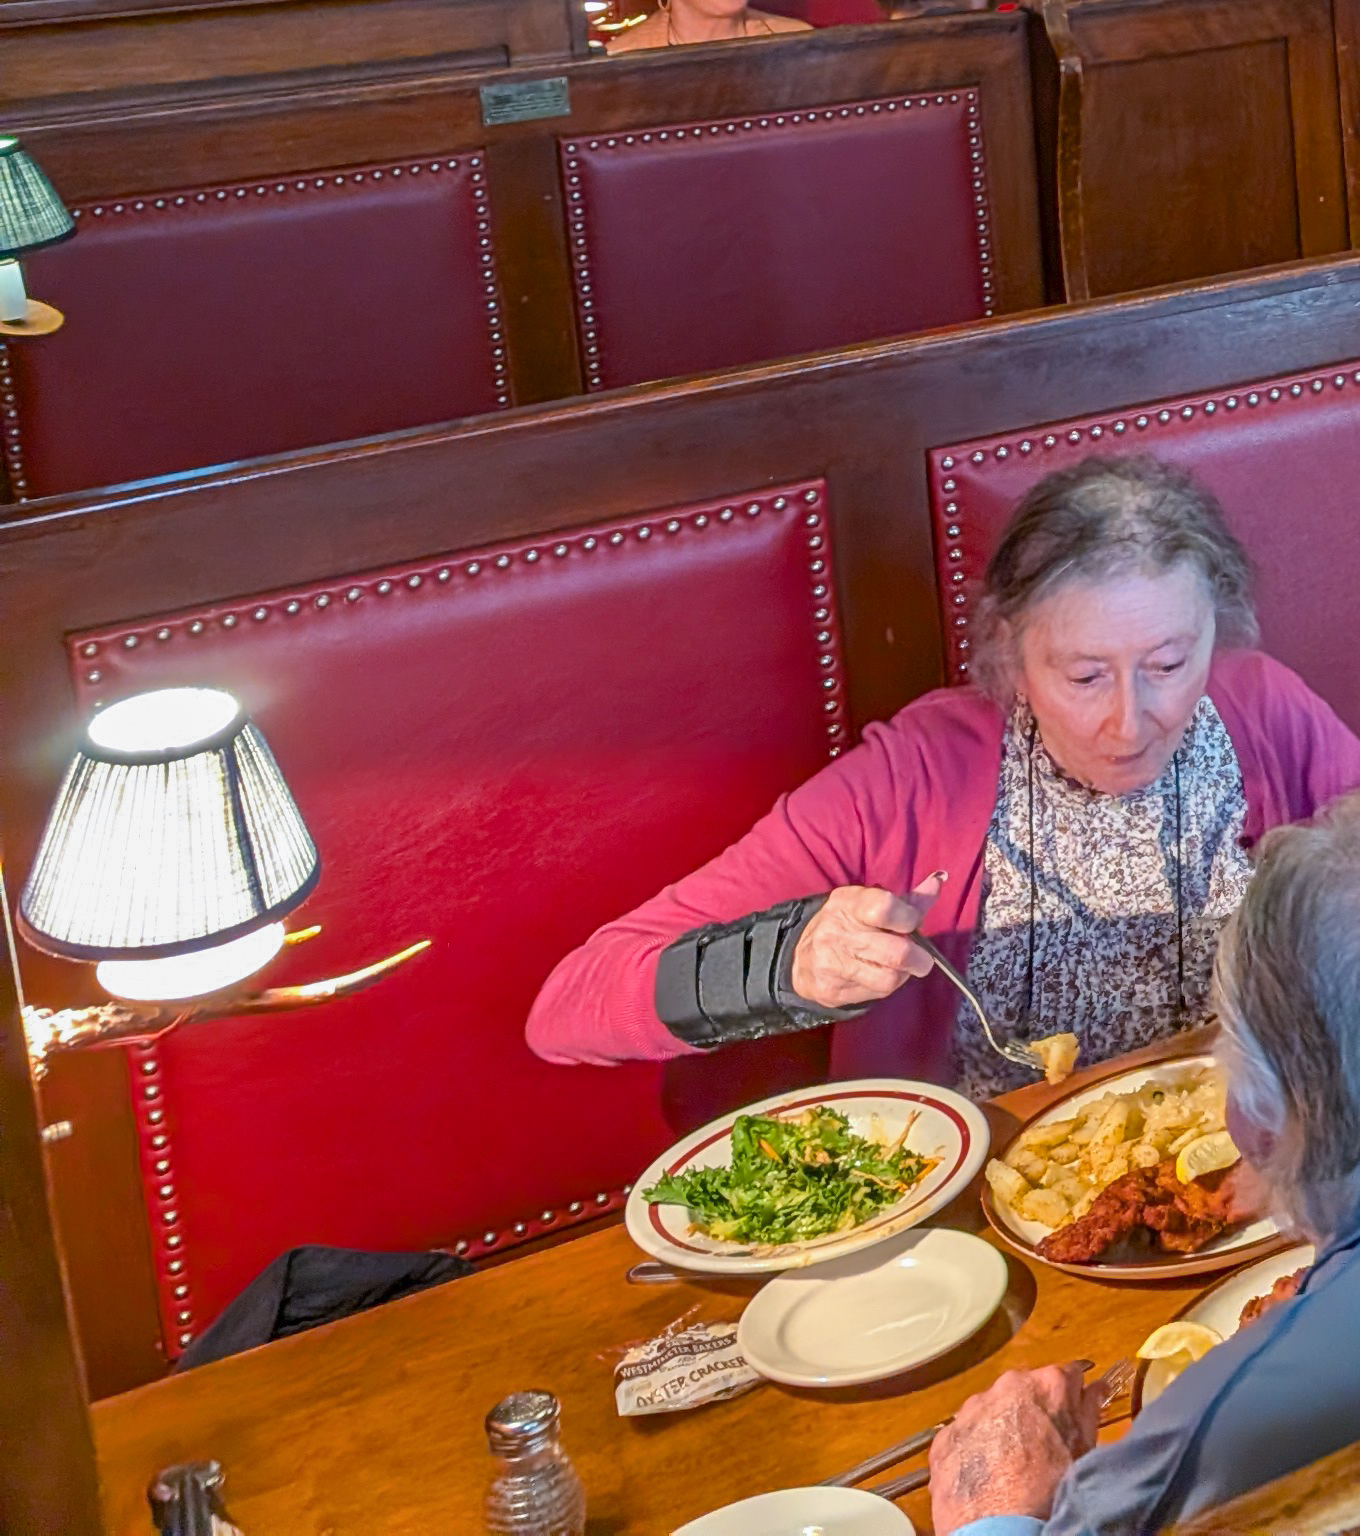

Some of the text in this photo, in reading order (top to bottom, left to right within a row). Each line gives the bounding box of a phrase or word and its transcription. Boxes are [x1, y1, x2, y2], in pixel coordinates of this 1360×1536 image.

[620, 1344, 692, 1379] WESTMINSTER
[692, 1337, 732, 1354] BAKERS
[636, 1375, 689, 1409] OYSTER
[689, 1355, 749, 1383] CRACKER
